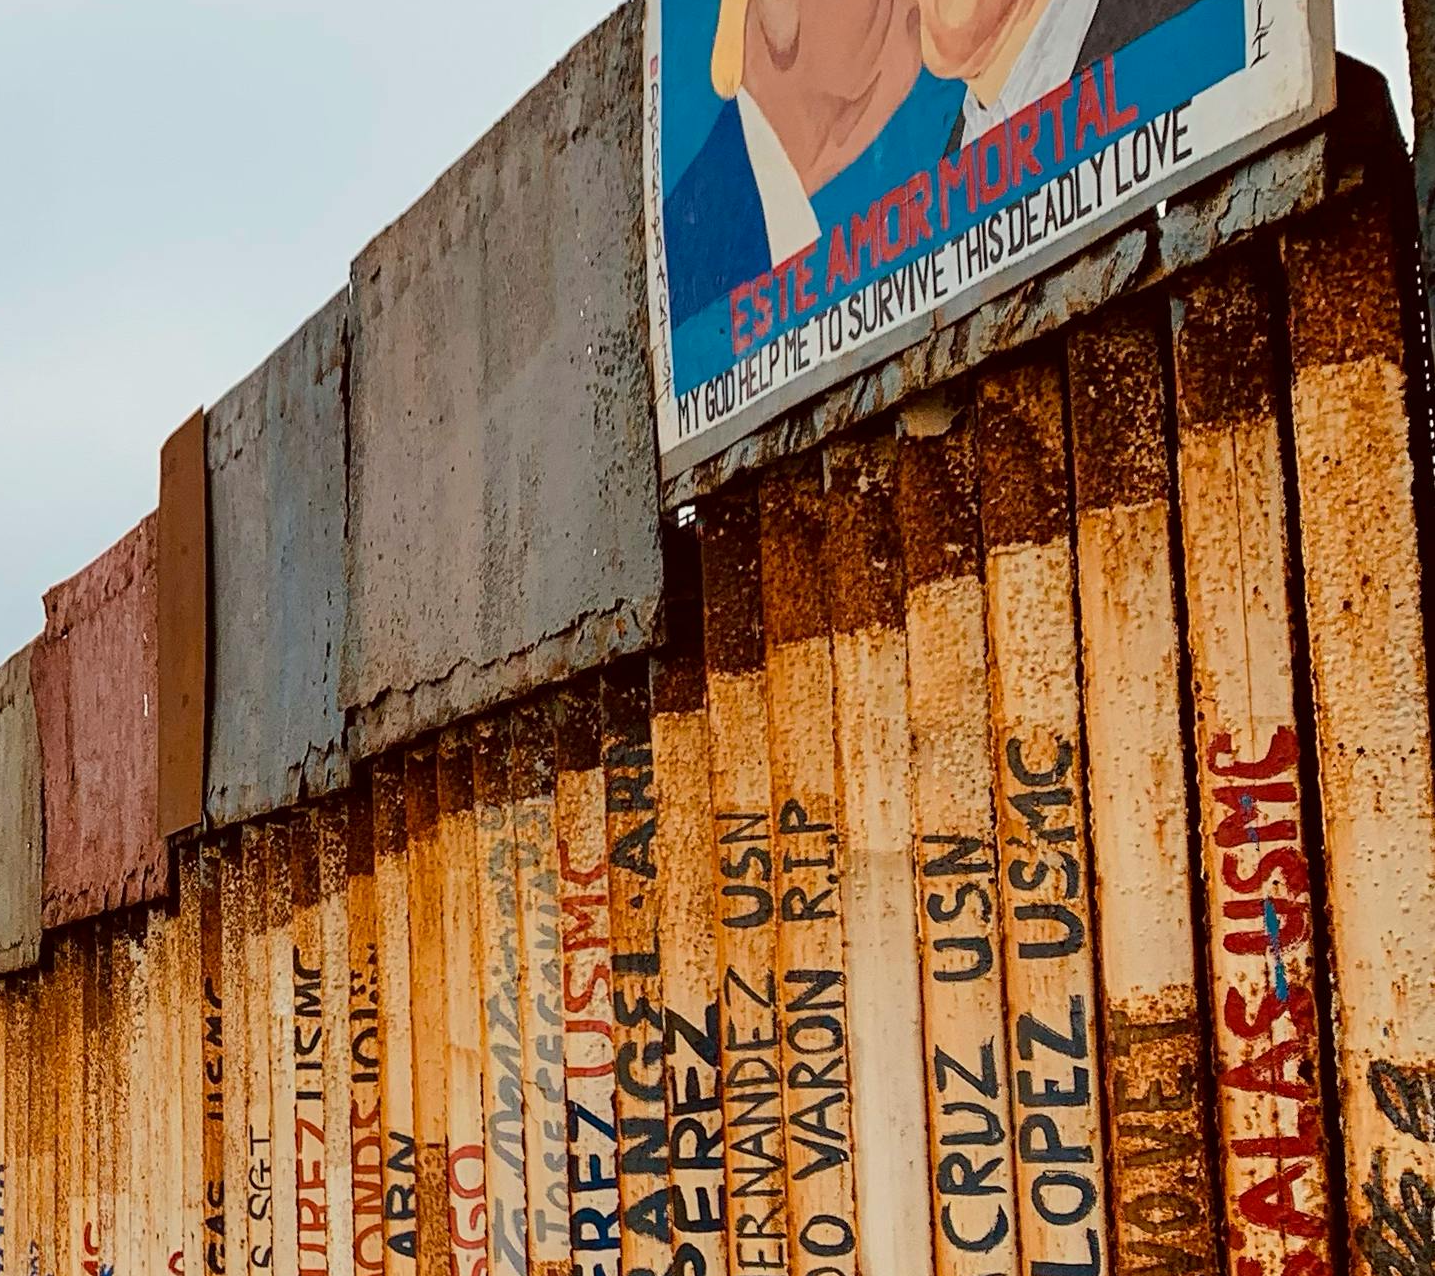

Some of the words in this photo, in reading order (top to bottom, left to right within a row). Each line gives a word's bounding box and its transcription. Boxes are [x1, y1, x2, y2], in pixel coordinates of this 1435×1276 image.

[677, 382, 700, 439] MY
[738, 333, 781, 405] HELP
[784, 321, 811, 379] ME
[814, 302, 843, 358] TO
[847, 244, 950, 341] SURVIVE
[950, 214, 1004, 286] THIS
[1005, 150, 1106, 268] DEADLY
[1114, 98, 1193, 197] LOVE
[729, 244, 819, 357] ESTE
[826, 170, 935, 294] AMOR
[938, 54, 1140, 231] MORTAL
[714, 810, 775, 930] USN
[922, 832, 994, 986] USN
[1004, 734, 1084, 962] USMC
[1202, 722, 1314, 960] USMC
[784, 967, 851, 1182] VARON
[934, 1036, 1009, 1256] CRUZ
